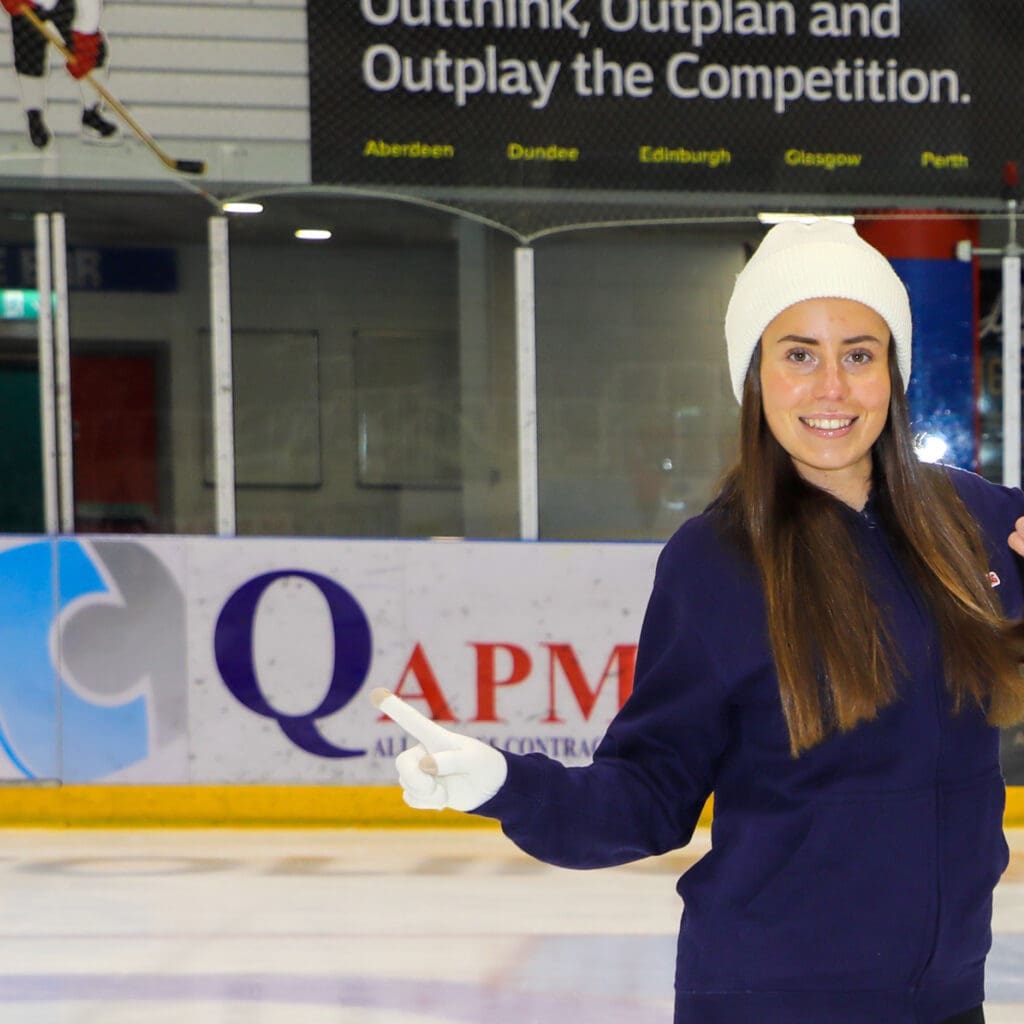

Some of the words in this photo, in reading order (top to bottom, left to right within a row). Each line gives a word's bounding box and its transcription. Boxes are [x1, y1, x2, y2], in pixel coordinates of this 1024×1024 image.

[601, 0, 796, 47] Outplan
[808, 0, 901, 38] and
[362, 43, 561, 109] Outplay
[571, 47, 655, 98] the
[666, 52, 971, 114] Competition.
[364, 140, 454, 158] Aberdeen
[507, 142, 579, 161] Dundee
[639, 145, 731, 167] Edinburgh
[785, 148, 861, 170] Glasgow
[921, 151, 968, 169] Perth
